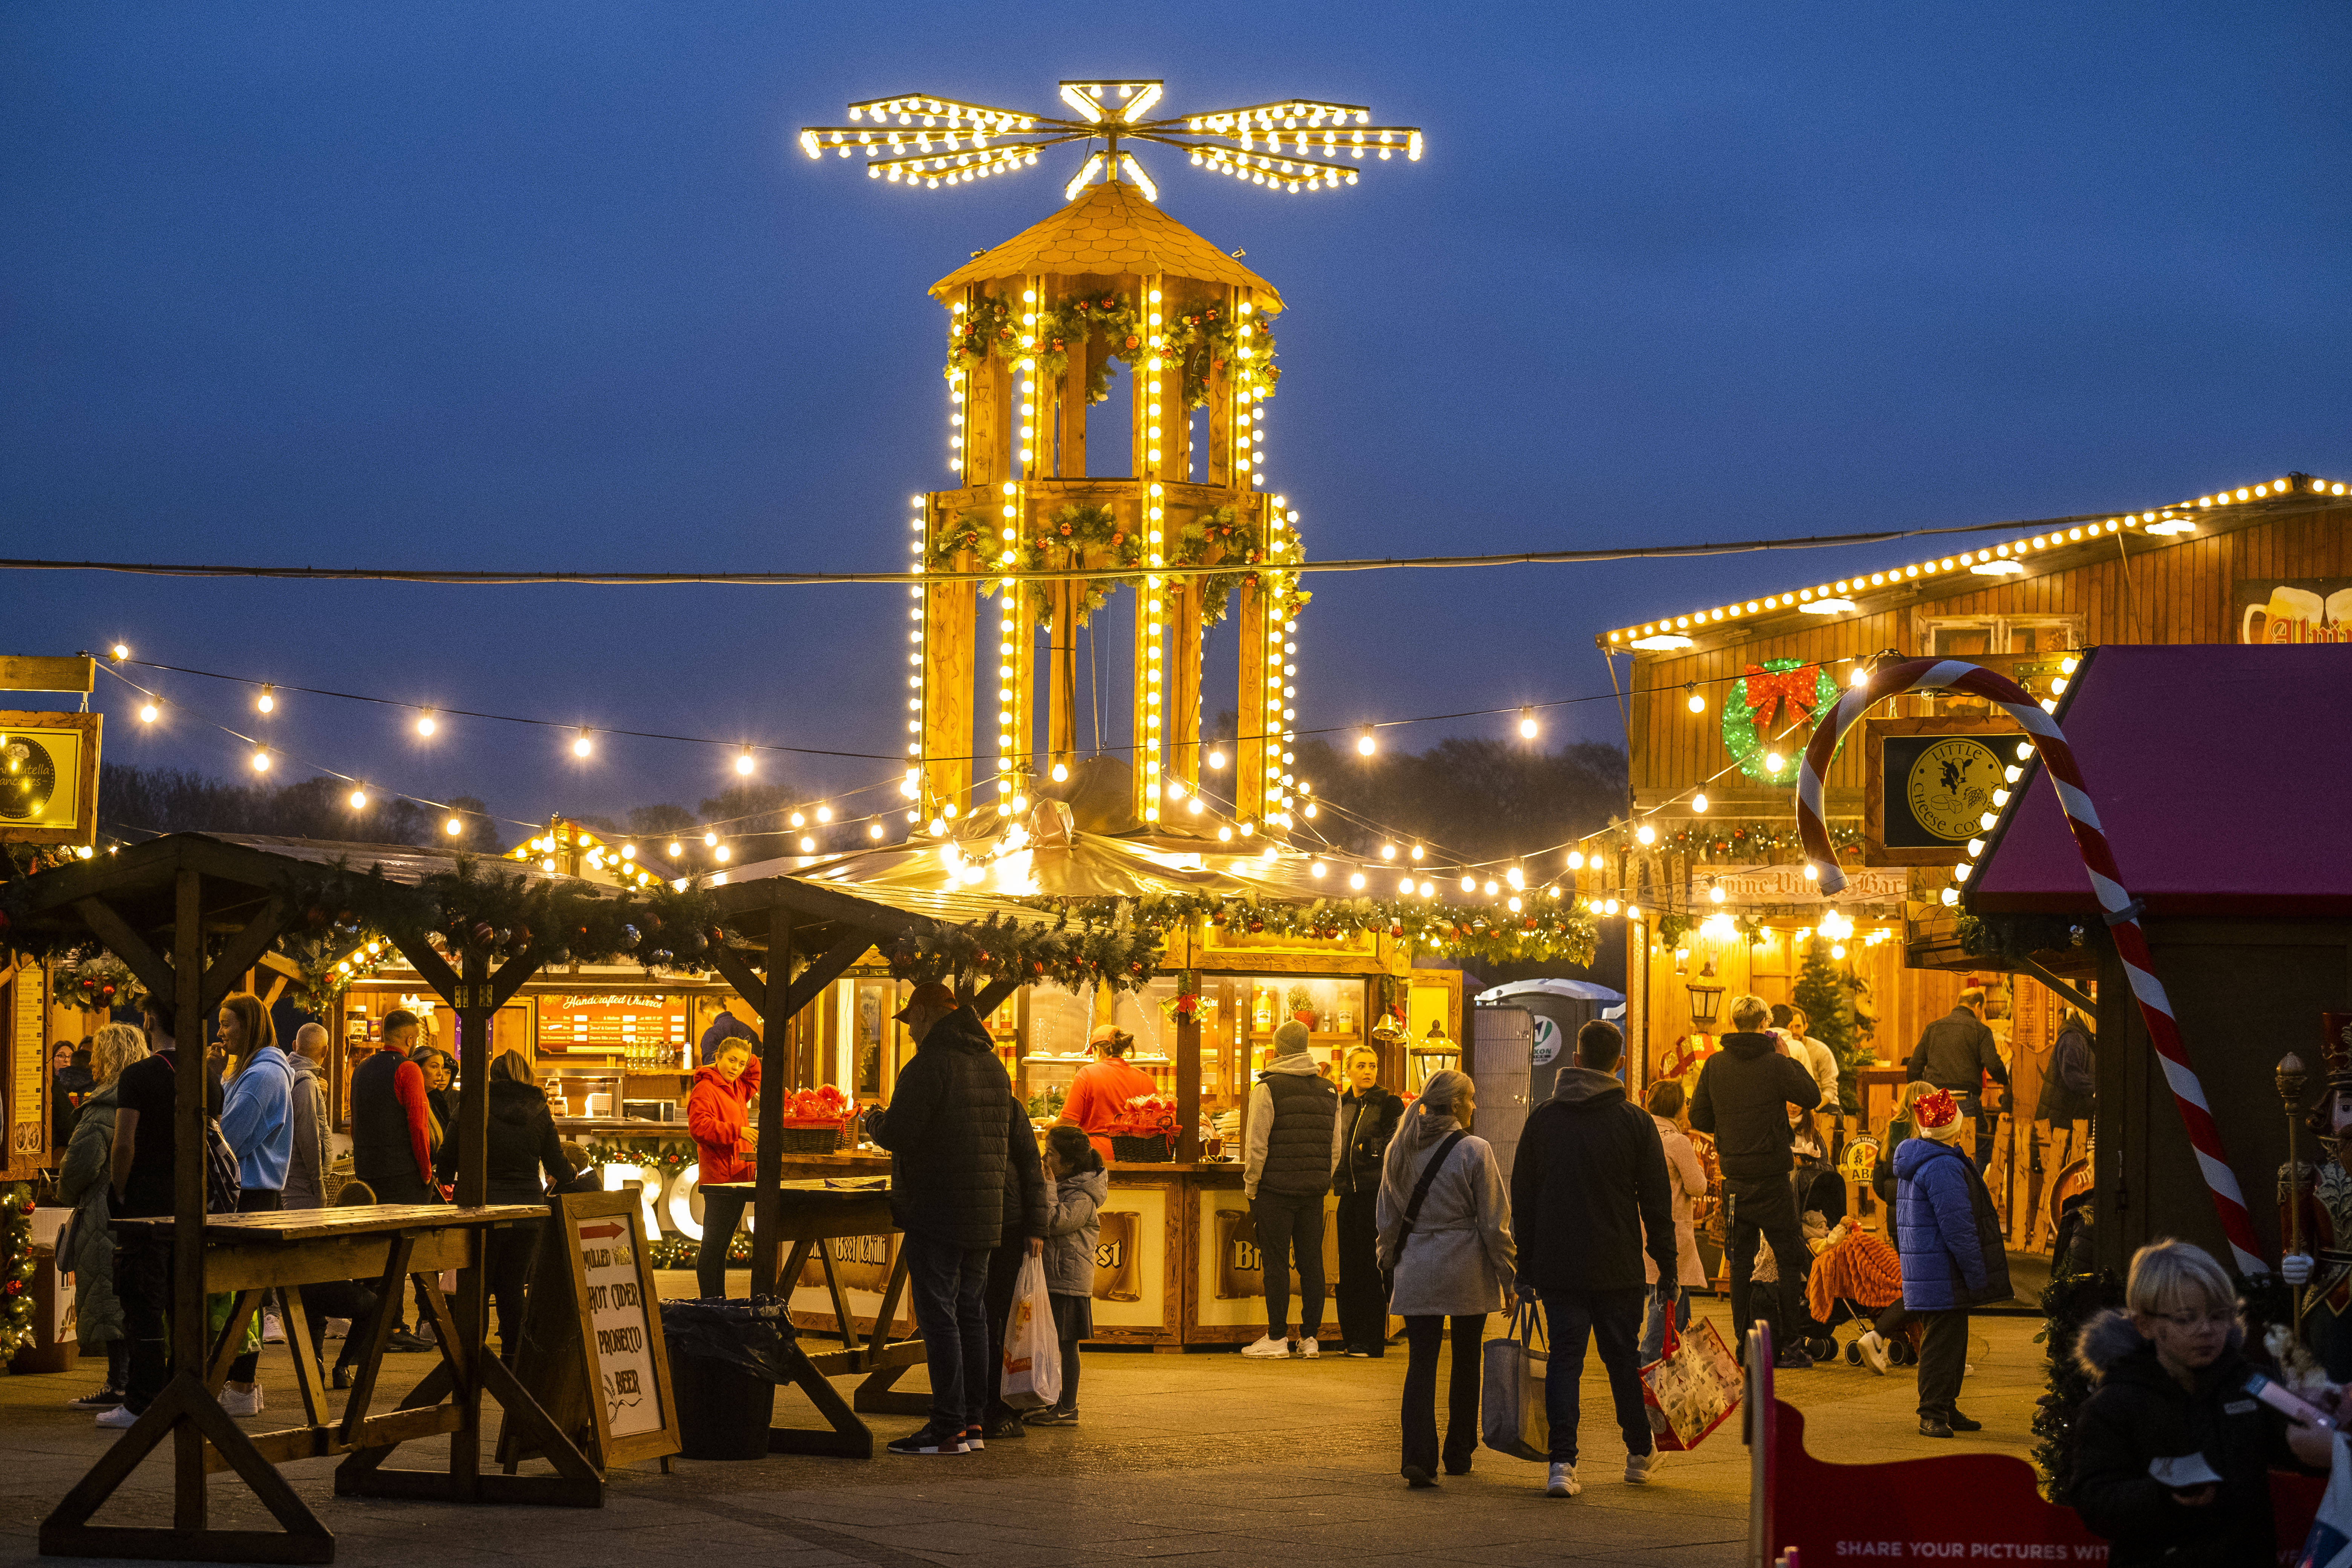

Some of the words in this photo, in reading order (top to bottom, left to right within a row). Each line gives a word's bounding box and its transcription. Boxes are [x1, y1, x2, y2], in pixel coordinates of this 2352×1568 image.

[0, 778, 41, 786] ancaes
[17, 763, 49, 775] utella
[1954, 781, 2001, 834] COAY
[1697, 871, 1769, 896] Apine
[1773, 871, 1853, 899] Vill
[1856, 871, 1903, 896] Bar
[563, 995, 626, 1009] Handcrafted
[627, 995, 663, 1008] Churros
[1851, 1137, 1861, 1145] 700
[1861, 1136, 1877, 1145] YEARS
[582, 1248, 611, 1271] MULLED
[612, 1245, 632, 1266] WINE
[859, 1234, 887, 1267] Chilli
[587, 1285, 608, 1314] HOT
[611, 1282, 640, 1311] CIDER
[597, 1326, 642, 1356] PROSECCO
[615, 1369, 641, 1395] BEER
[1836, 1540, 1903, 1557] SHARE
[1909, 1542, 1965, 1558] YOUR
[1970, 1543, 2068, 1560] PICTURES
[2074, 1545, 2109, 1560] WIT
